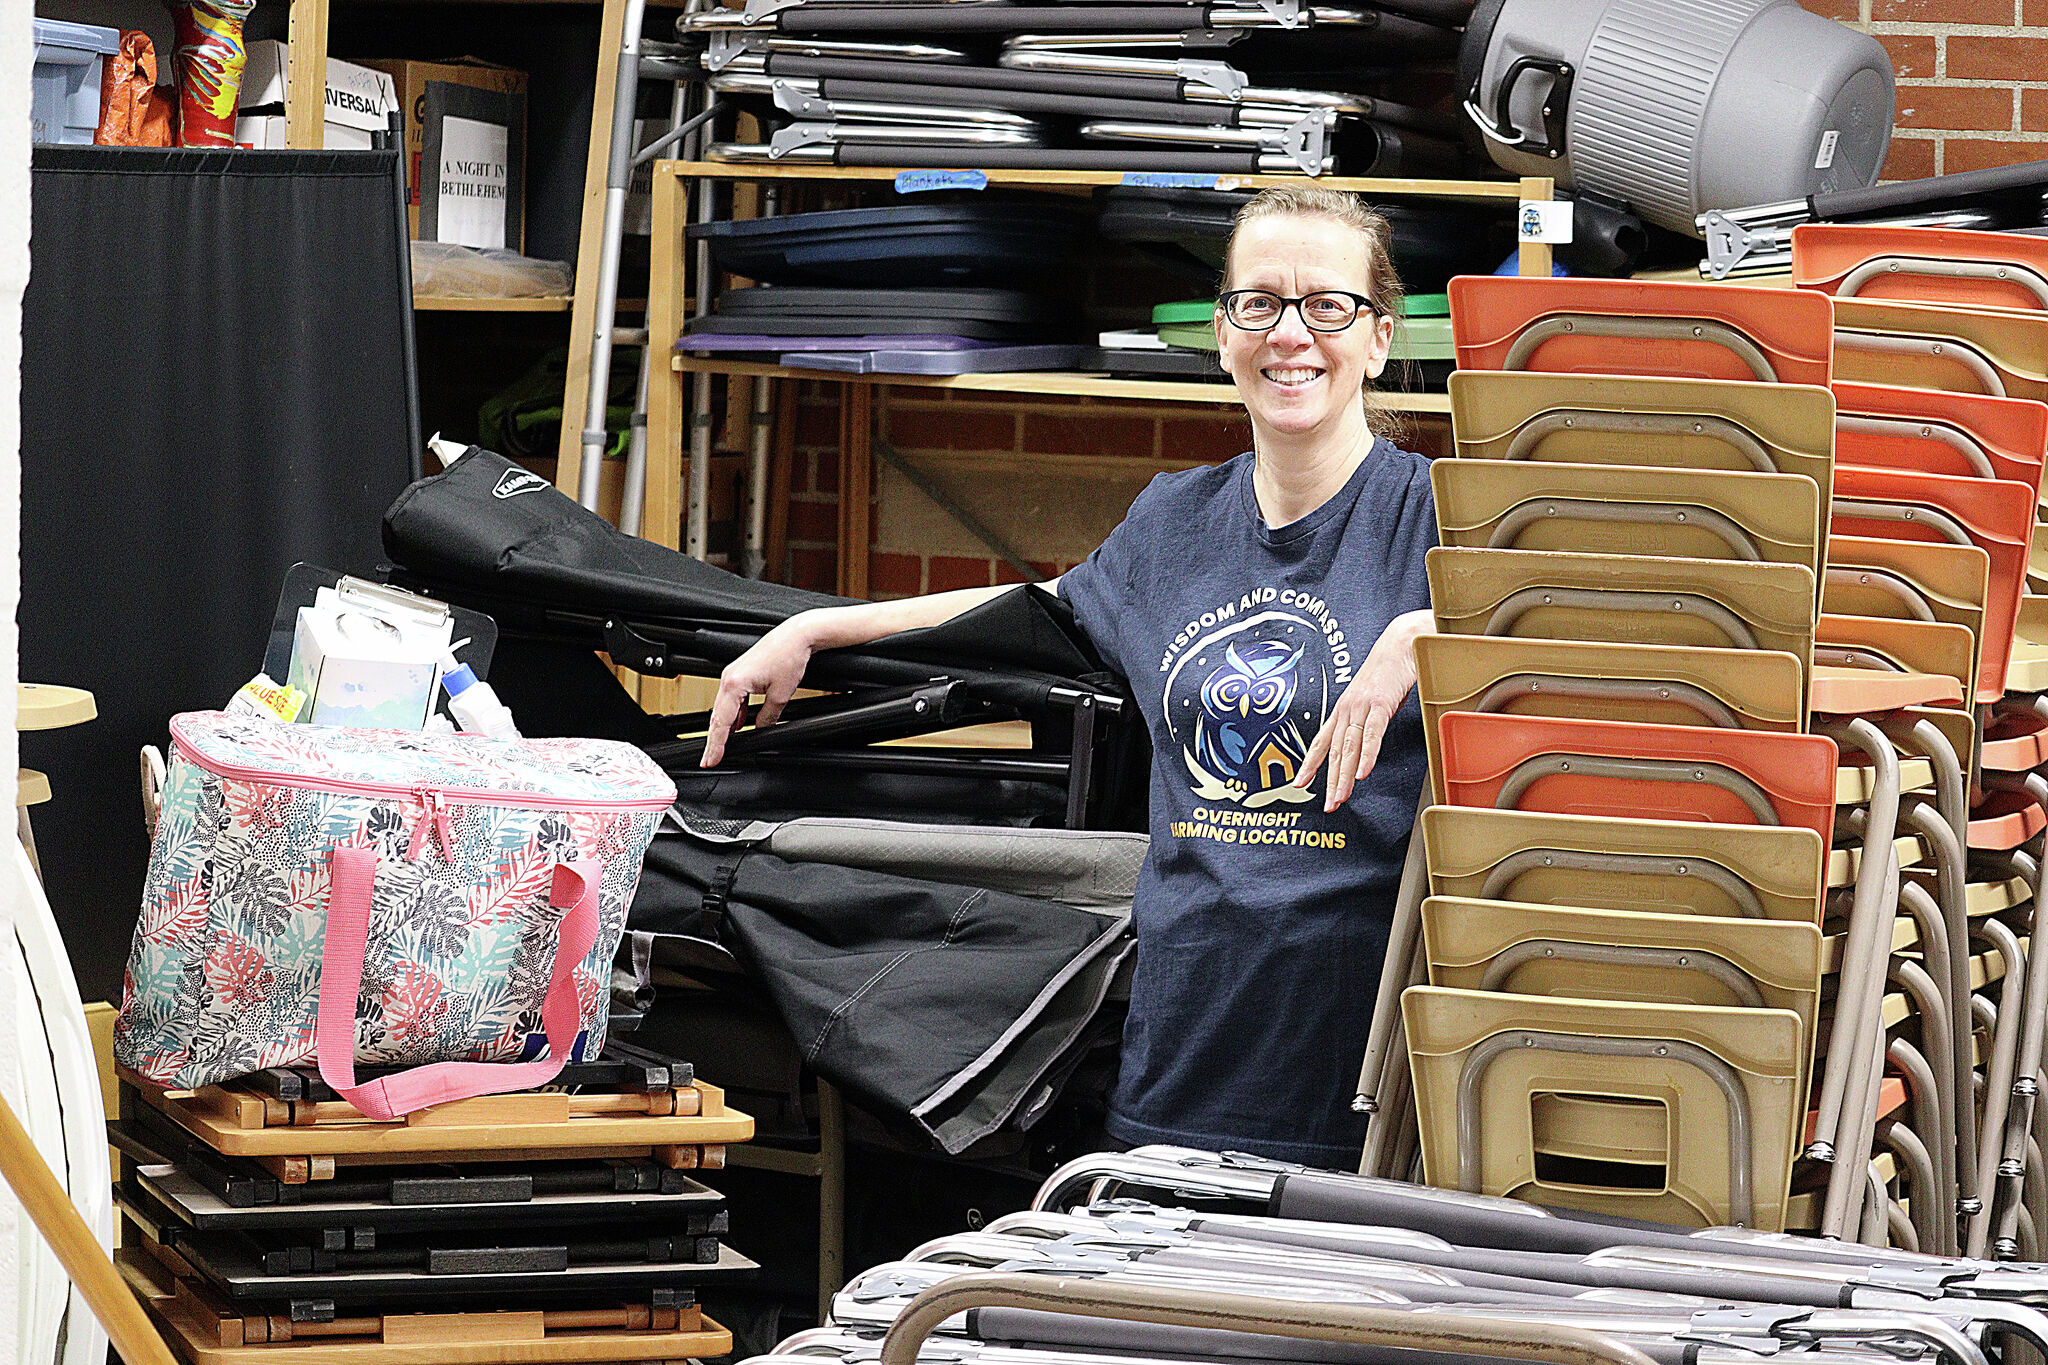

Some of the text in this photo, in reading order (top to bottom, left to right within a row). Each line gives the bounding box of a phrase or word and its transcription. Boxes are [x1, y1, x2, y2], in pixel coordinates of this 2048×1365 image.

[325, 88, 381, 117] IVERSAL
[442, 160, 505, 179] A NIGHT IN
[441, 181, 505, 200] BETHLEHEM
[1159, 602, 1236, 672] WISDOM
[1239, 587, 1278, 612] AND
[1192, 807, 1302, 828] OVERNIGHT
[1238, 829, 1347, 849] LOCATIONS
